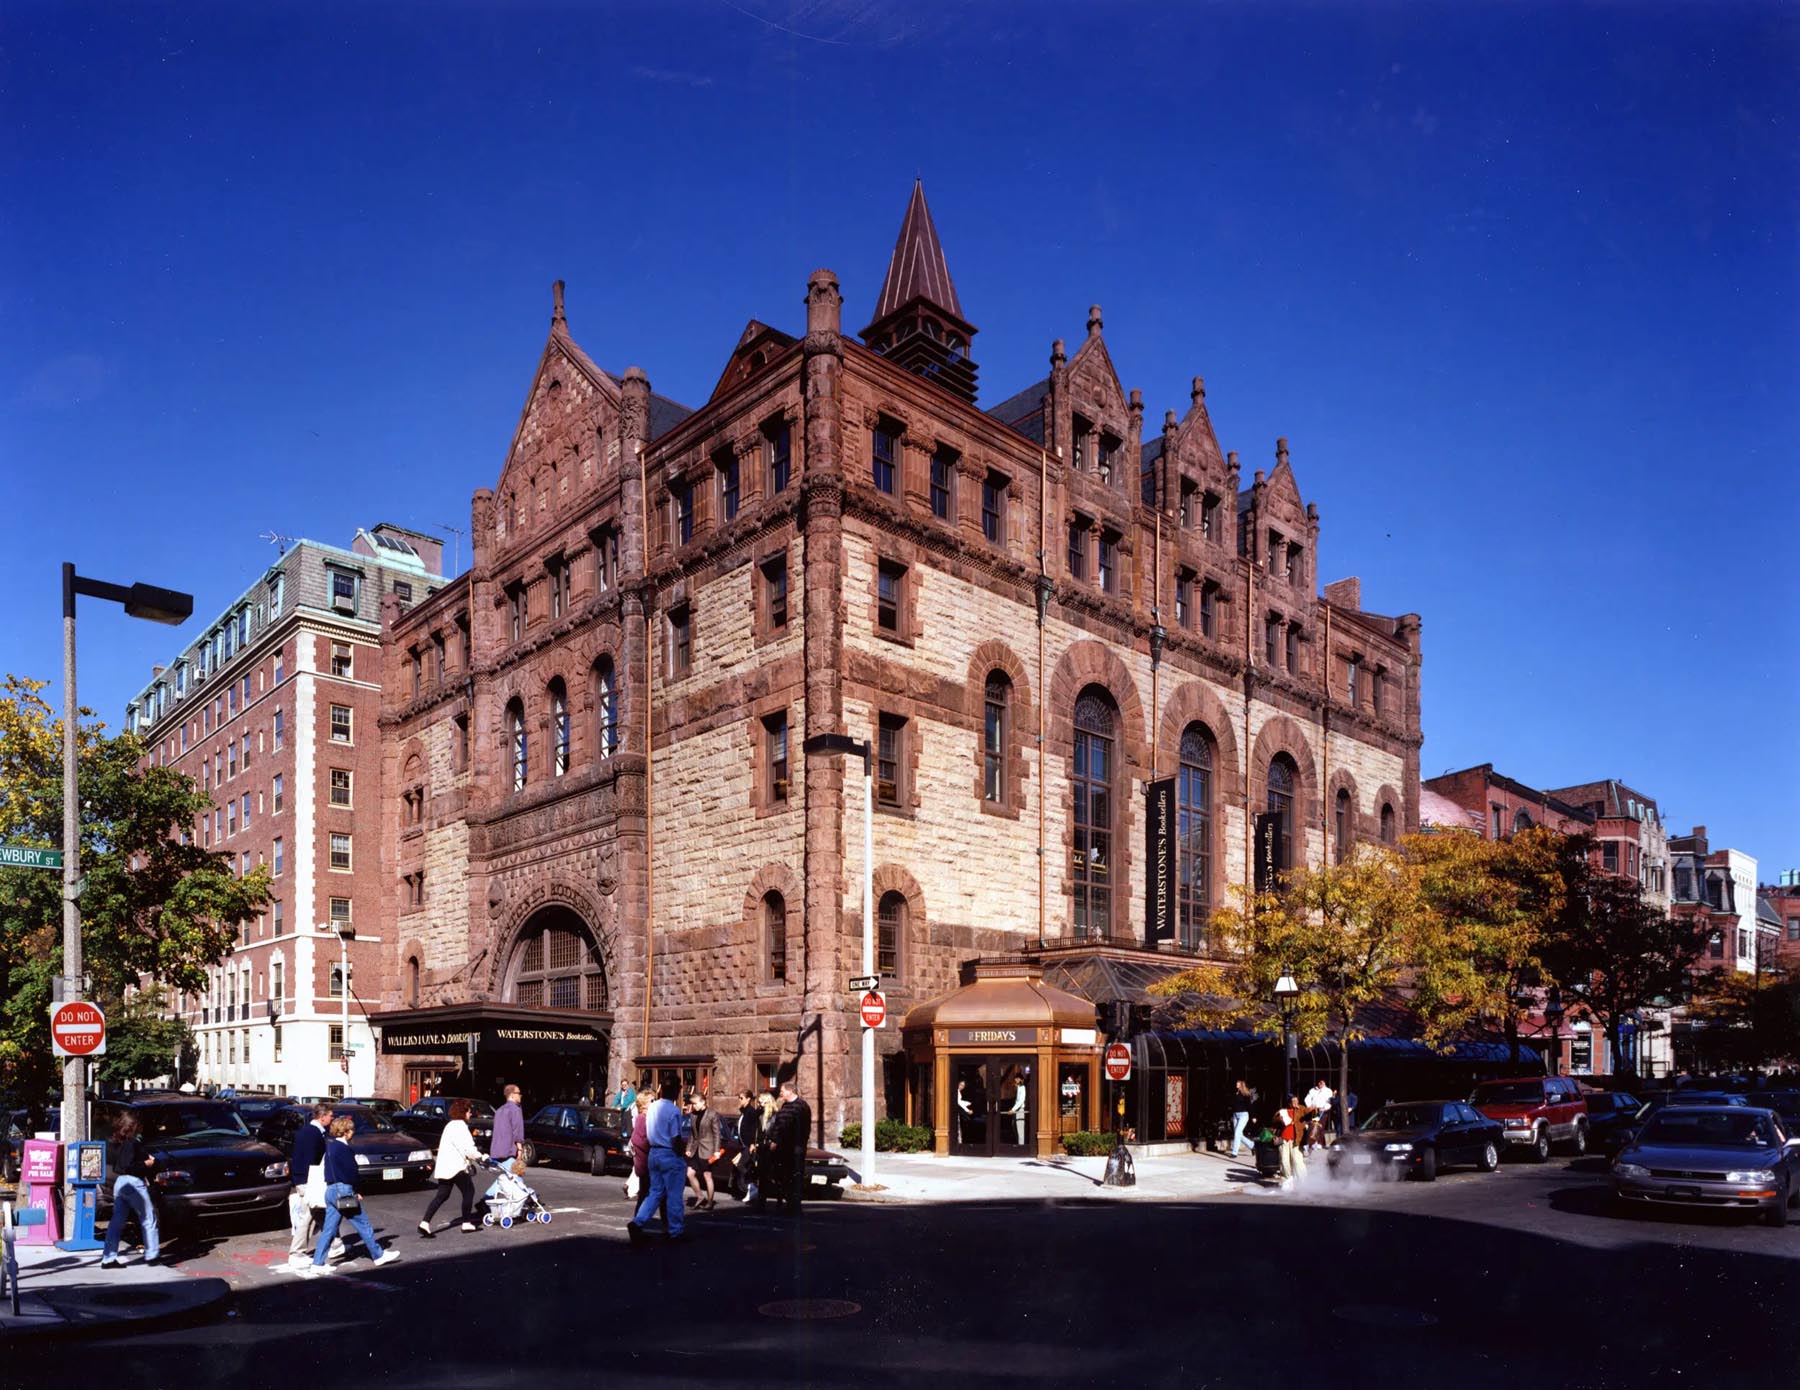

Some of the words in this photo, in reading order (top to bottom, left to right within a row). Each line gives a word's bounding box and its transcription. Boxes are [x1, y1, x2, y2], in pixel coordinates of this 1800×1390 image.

[1157, 790, 1167, 835] Booksellers
[0, 848, 41, 864] WBURY
[45, 857, 54, 866] ST
[1157, 838, 1167, 930] WATERSTONE'S
[60, 1011, 74, 1022] DO
[76, 1011, 95, 1022] NOT
[64, 1035, 94, 1046] ENTER
